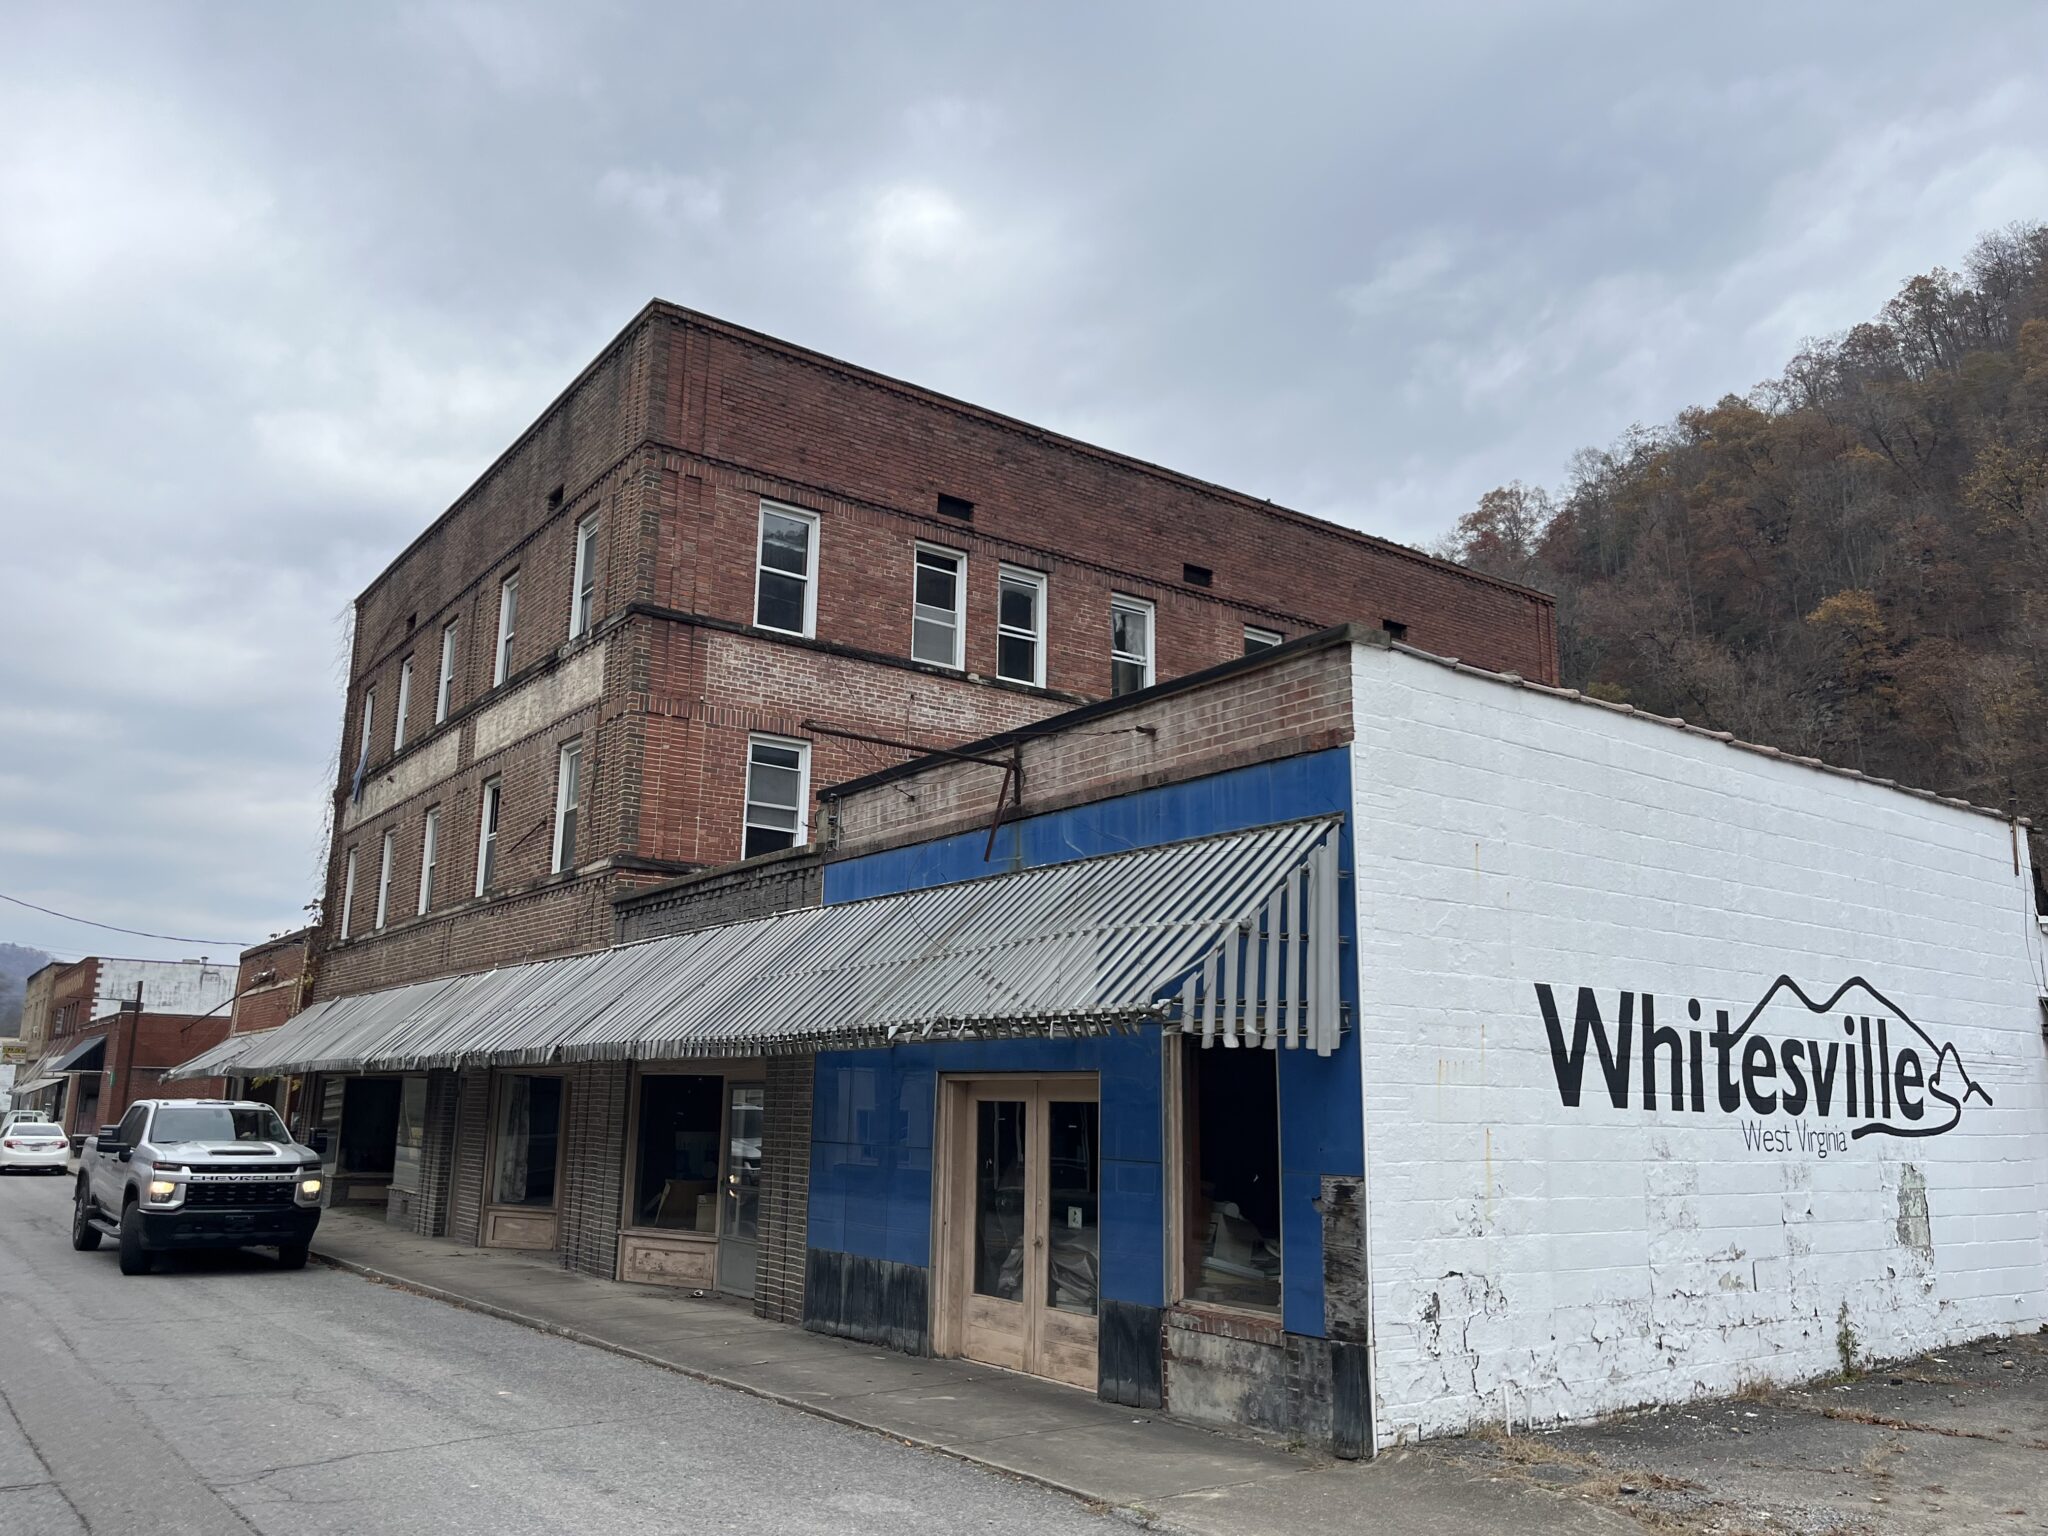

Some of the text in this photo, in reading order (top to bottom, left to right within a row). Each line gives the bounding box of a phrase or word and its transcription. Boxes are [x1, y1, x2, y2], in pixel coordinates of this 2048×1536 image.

[1534, 982, 1925, 1121] Whitesville
[1741, 1118, 1848, 1158] West Virginia
